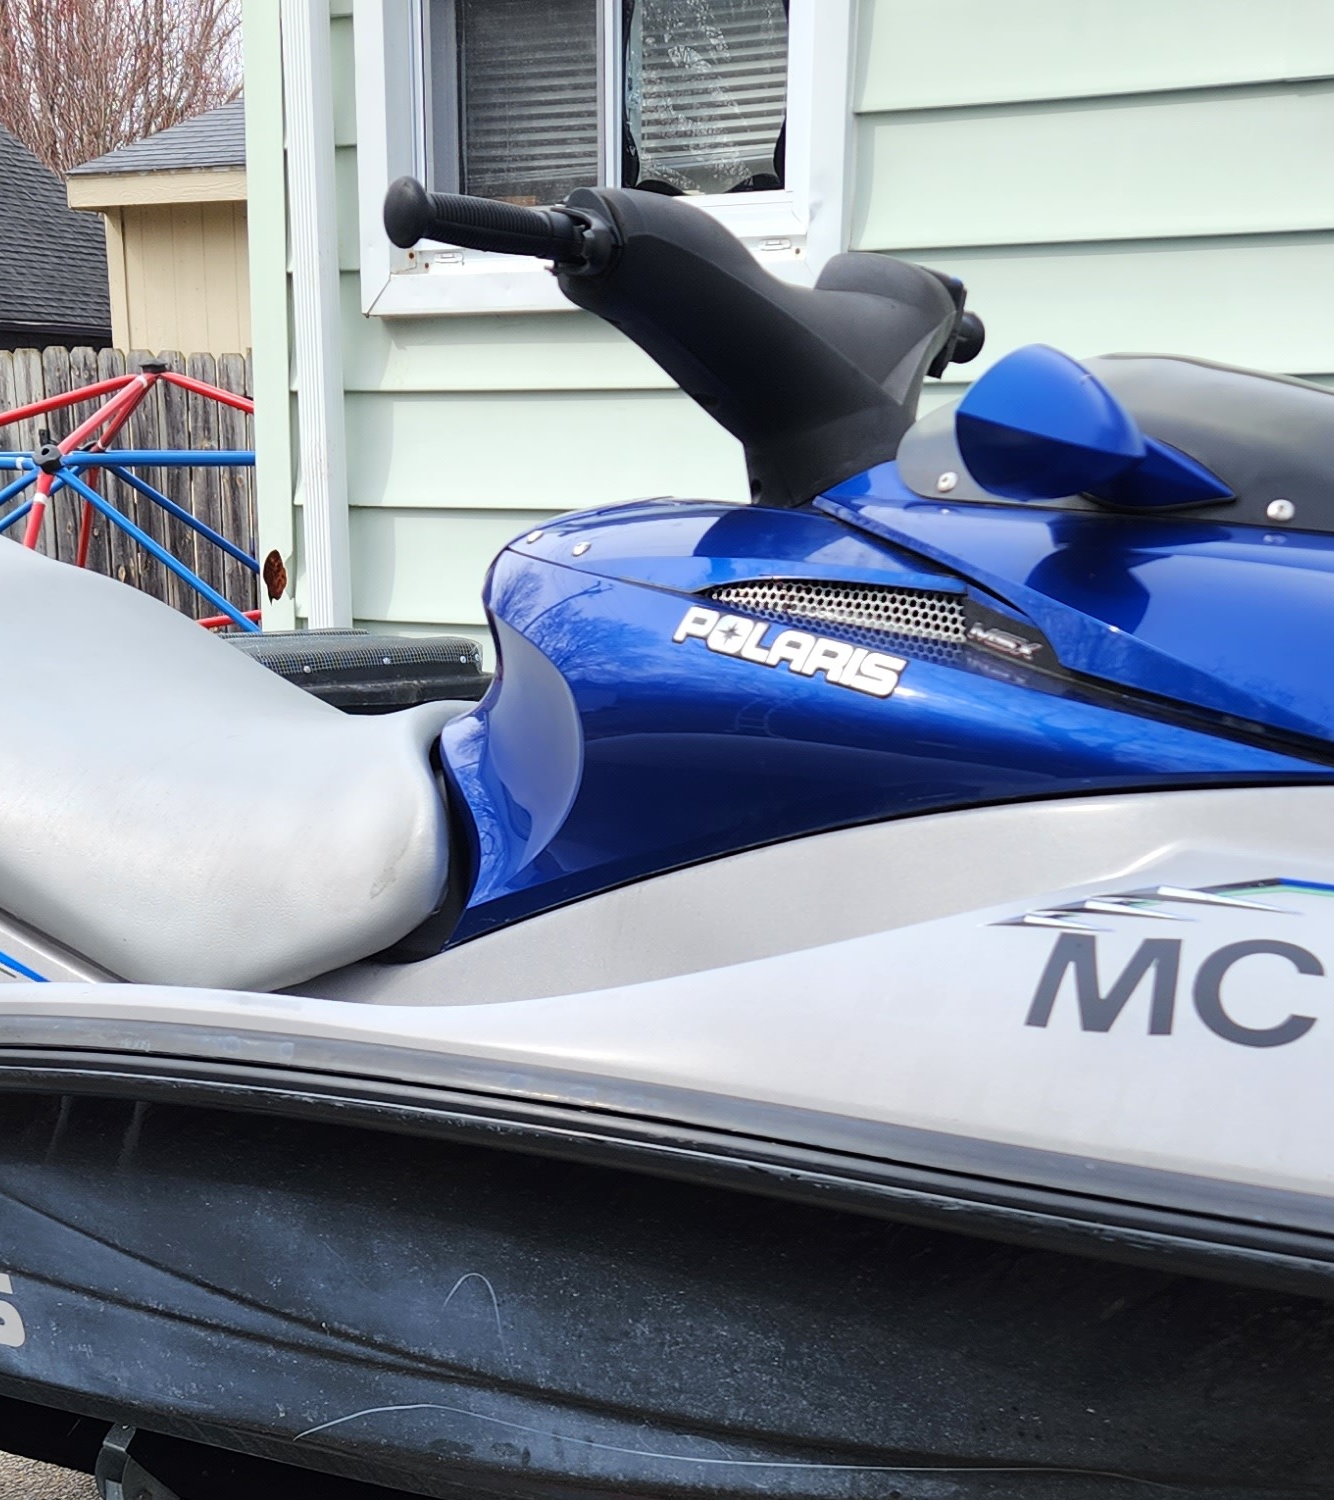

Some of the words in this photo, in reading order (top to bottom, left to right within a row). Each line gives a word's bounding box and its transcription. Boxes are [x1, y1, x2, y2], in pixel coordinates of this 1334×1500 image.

[673, 605, 909, 699] POLARIS
[967, 622, 1043, 660] MSX
[1024, 932, 1326, 1048] MC
